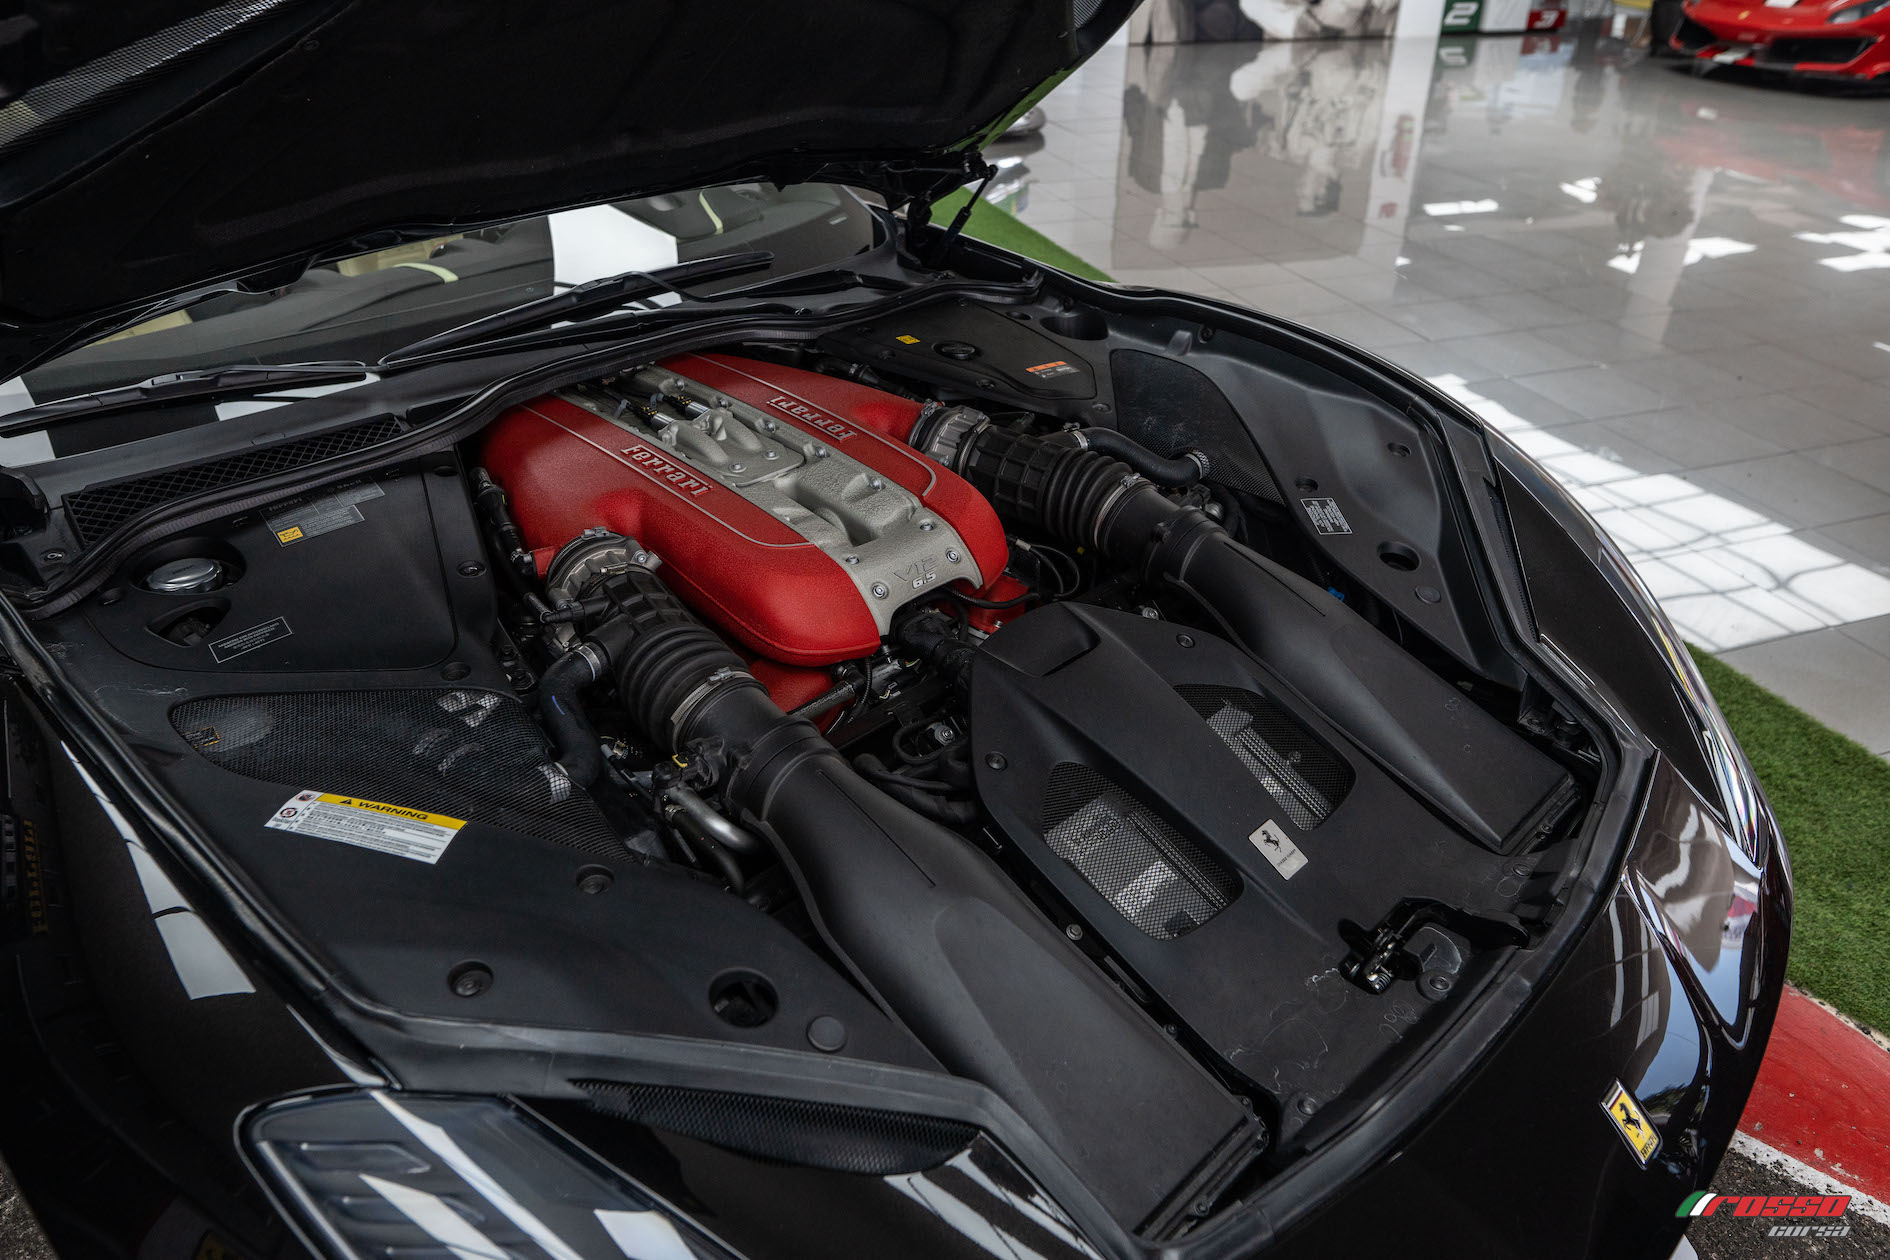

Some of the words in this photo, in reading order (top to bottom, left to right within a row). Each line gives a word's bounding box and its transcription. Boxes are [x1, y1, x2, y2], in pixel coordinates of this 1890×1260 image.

[1443, 2, 1479, 27] 2
[766, 395, 858, 441] Ferrari
[621, 443, 713, 497] Ferrari
[893, 553, 938, 582] V12
[912, 571, 937, 590] 6.5
[358, 801, 429, 821] WARNING
